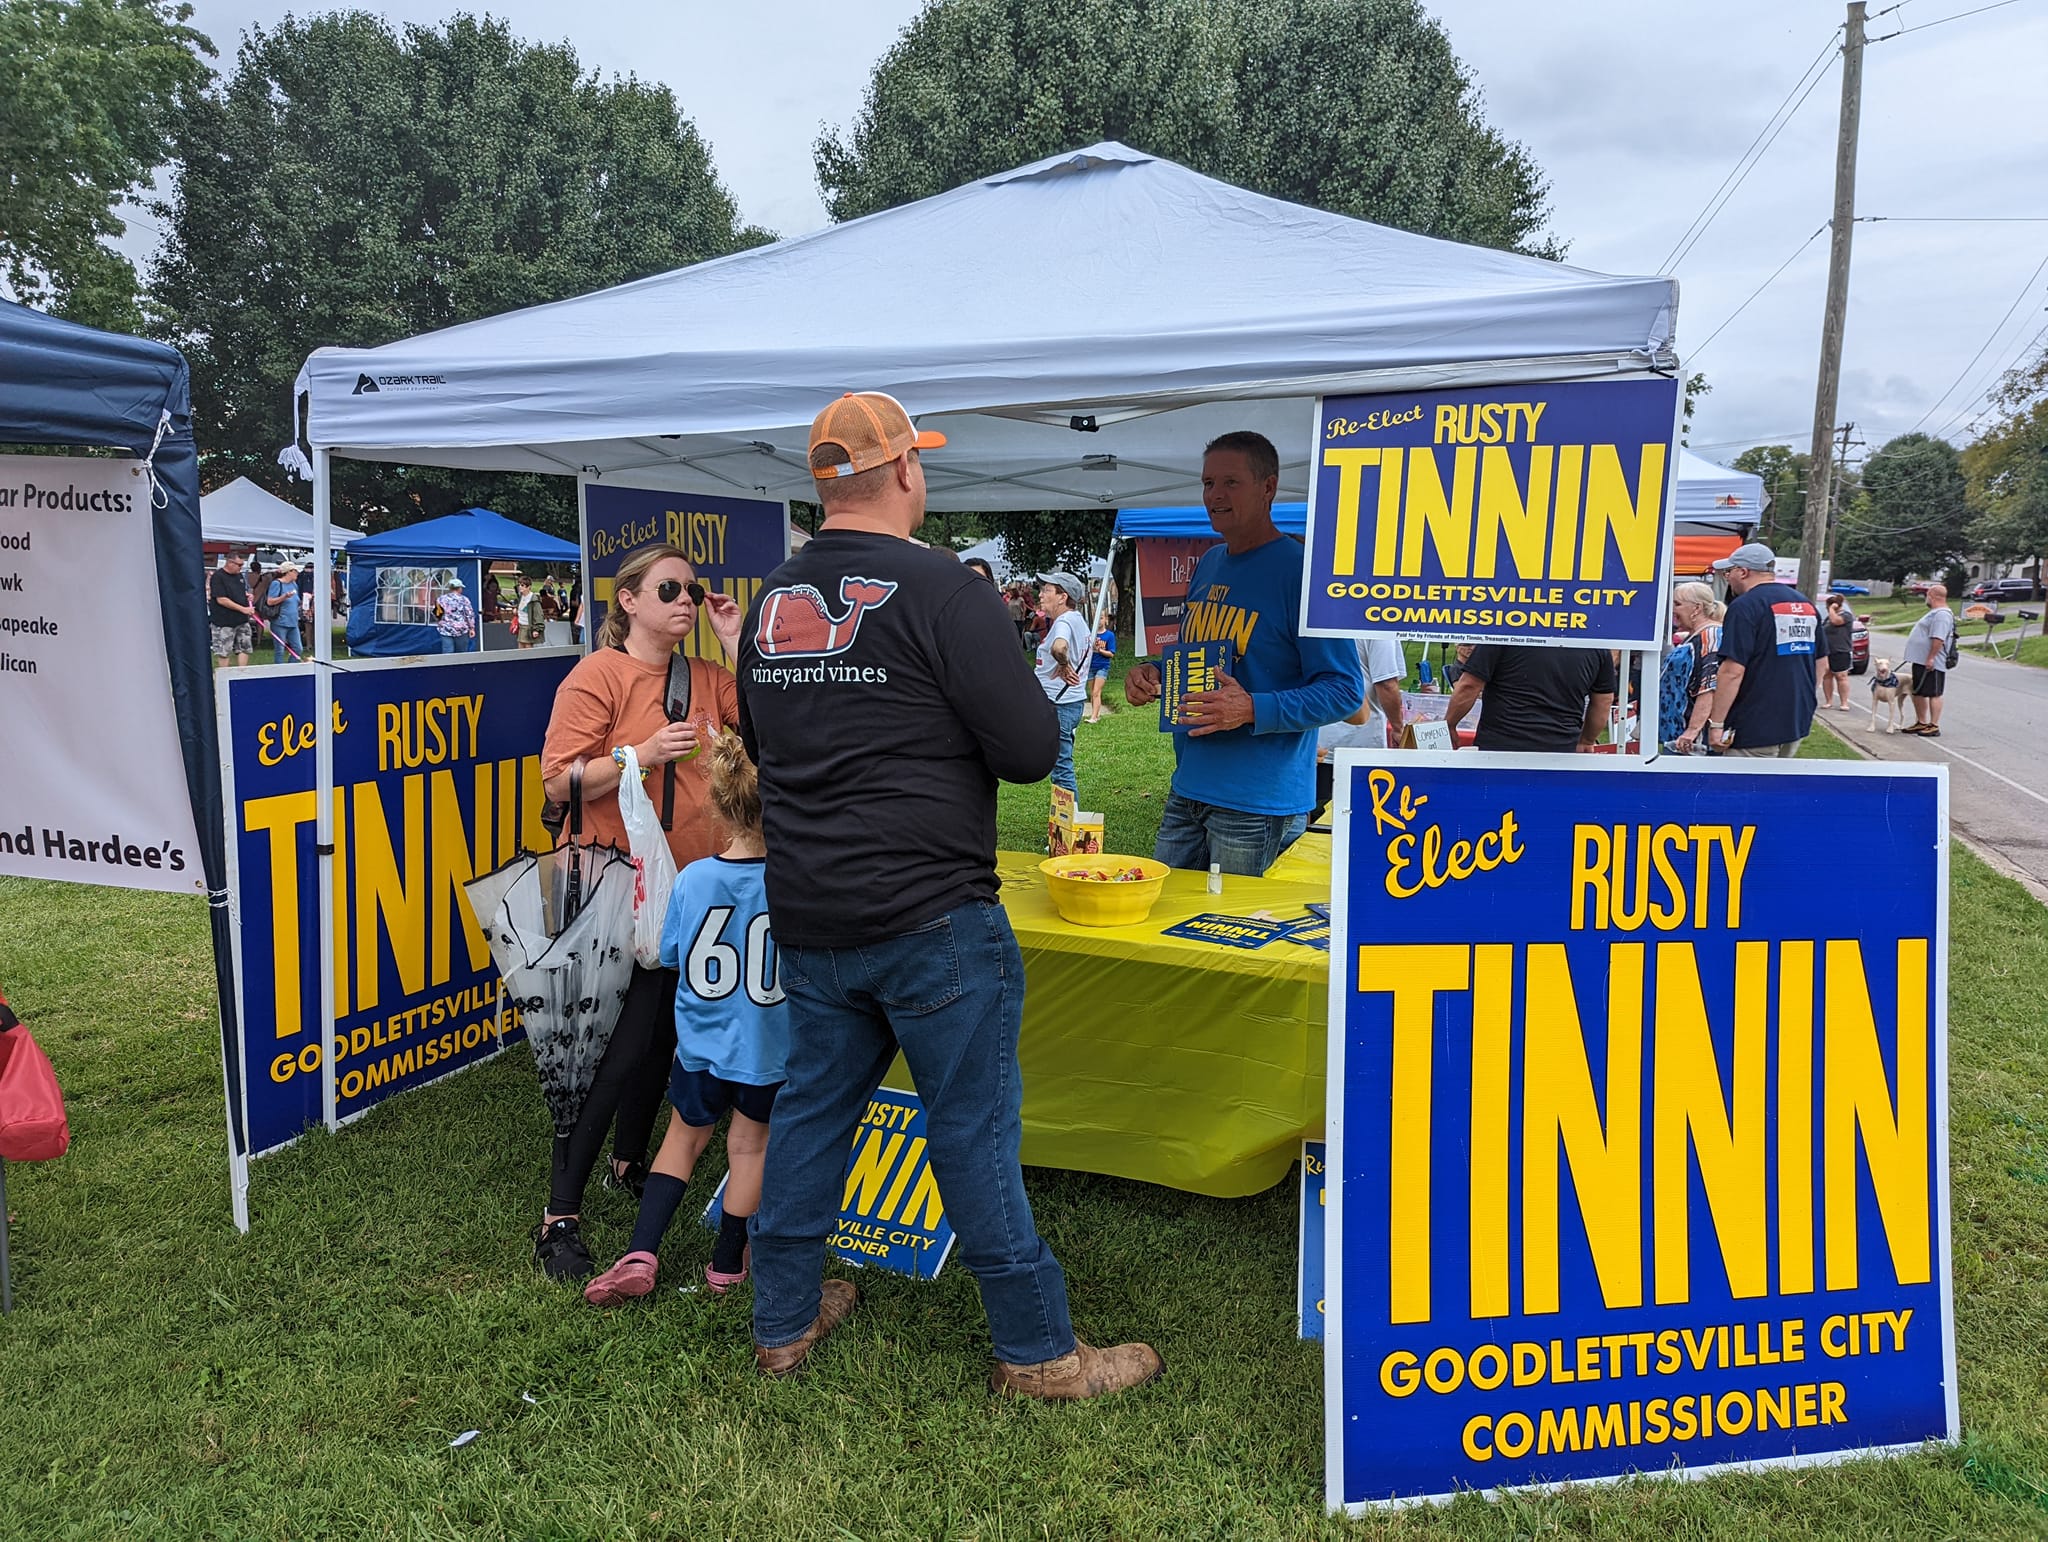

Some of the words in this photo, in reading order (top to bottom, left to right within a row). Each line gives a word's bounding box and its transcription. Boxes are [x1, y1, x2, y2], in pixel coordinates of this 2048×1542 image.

[1326, 404, 1424, 440] Re-Elect
[1434, 402, 1547, 444] RUSTY
[24, 484, 132, 512] Products:
[1323, 443, 1666, 582] TINNIN
[0, 532, 30, 550] ood
[592, 515, 659, 561] Re-Elect
[665, 510, 728, 565] RUSTY
[1326, 582, 1564, 604] GOODLETTSVILLE
[1573, 589, 1638, 606] CITY
[1364, 606, 1588, 629] COMMISSIONER
[0, 617, 58, 636] apeake
[752, 661, 825, 690] vineyard
[828, 660, 887, 683] vines
[257, 700, 348, 767] Elet
[377, 694, 484, 772] RUSTY
[1368, 769, 1429, 836] Re-
[42, 829, 185, 871] Hardee's
[1384, 810, 1525, 898] Elect
[1570, 823, 1756, 931] RUSTY
[1185, 921, 1271, 940] TINNIN
[685, 905, 787, 1008] 60
[1357, 938, 1932, 1325] TINNIN
[888, 1231, 936, 1251] CITY
[1379, 1319, 1805, 1398] GOODLETTSVILLE
[1820, 1310, 1914, 1359] CITY
[1462, 1382, 1848, 1462] COMMISSIONER
